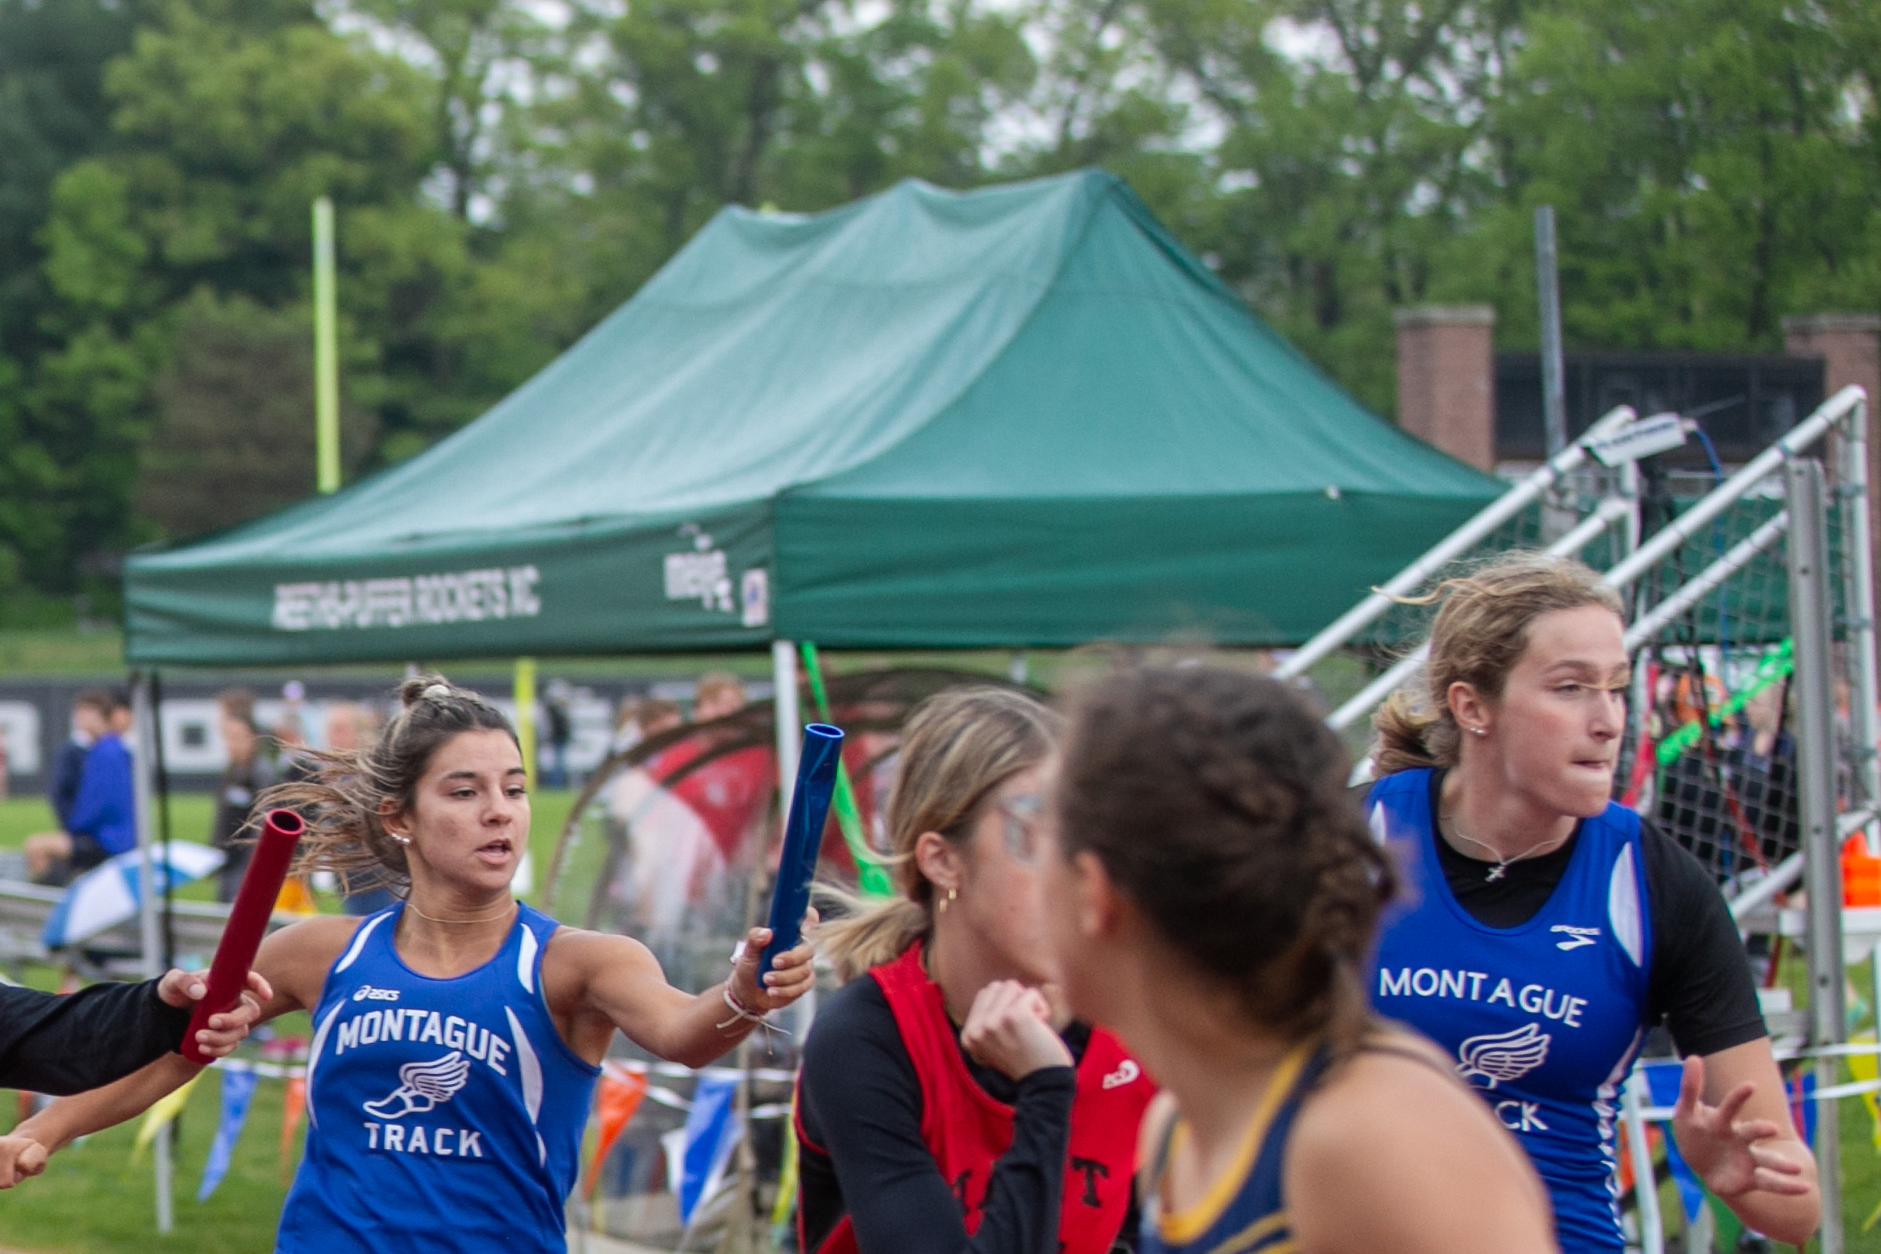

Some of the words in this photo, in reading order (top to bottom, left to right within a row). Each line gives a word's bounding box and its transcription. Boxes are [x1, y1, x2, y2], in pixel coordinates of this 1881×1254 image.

[1379, 966, 1589, 1029] MONTAGUE
[335, 1008, 512, 1077] MONTAGUE
[363, 1121, 484, 1159] TRACK
